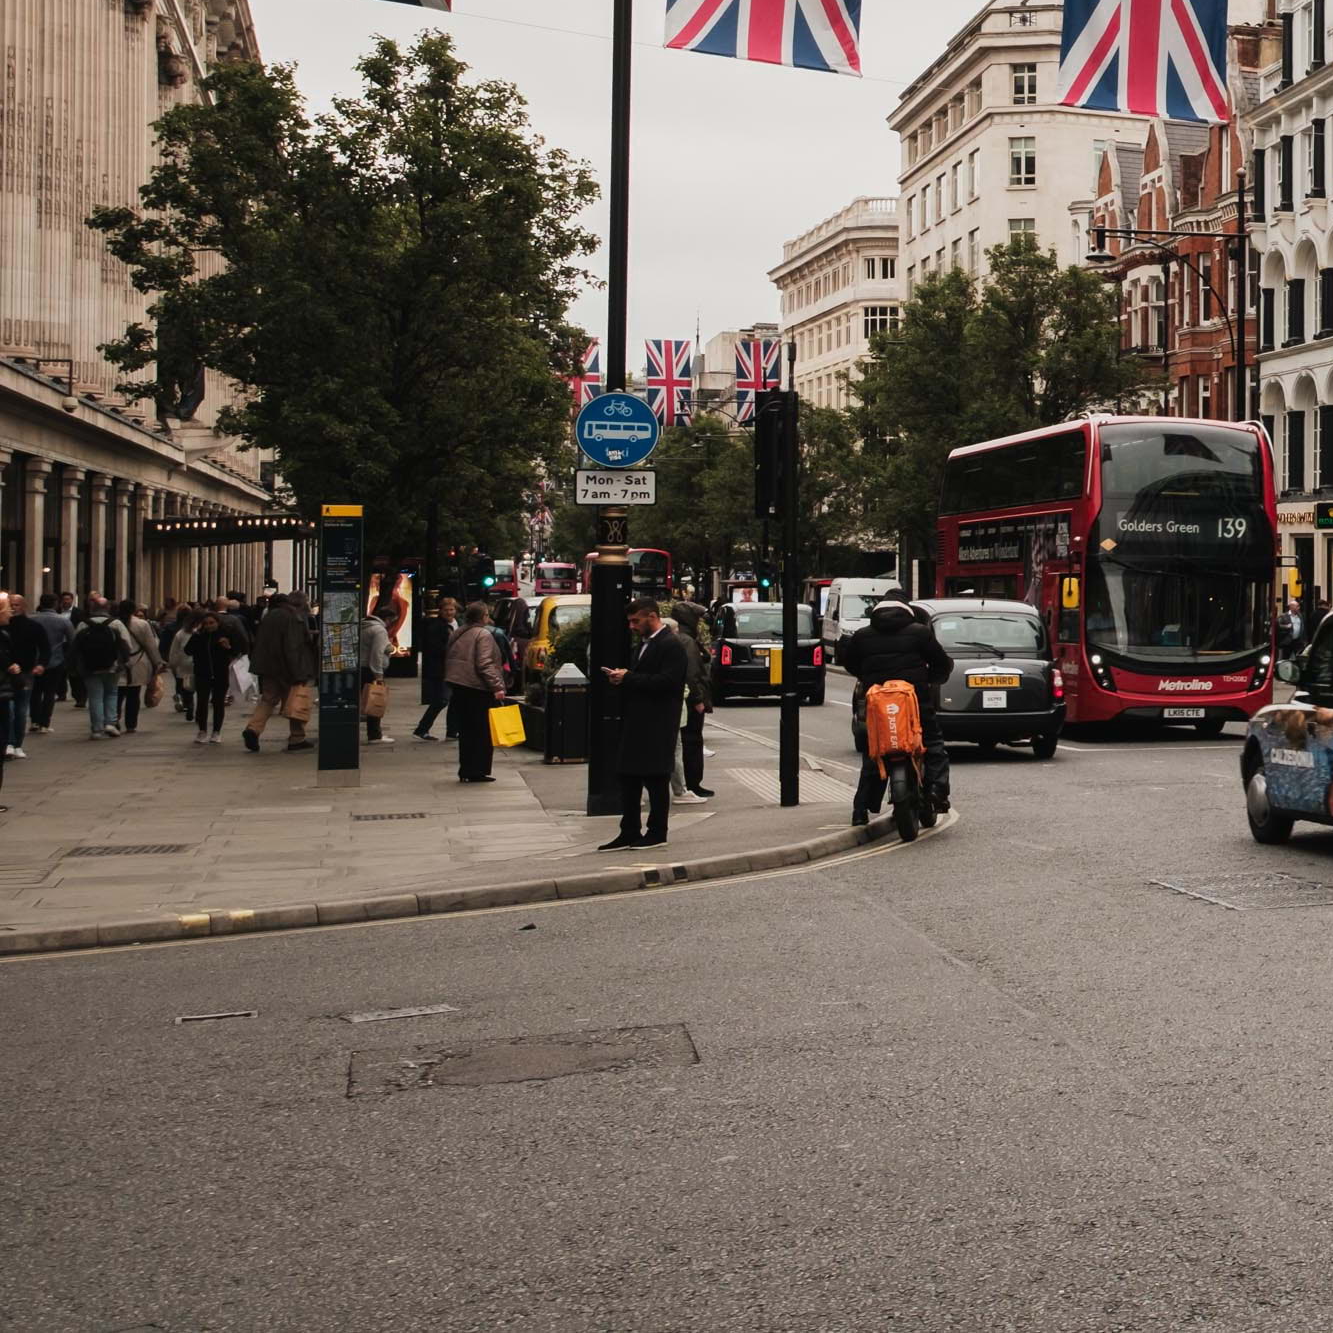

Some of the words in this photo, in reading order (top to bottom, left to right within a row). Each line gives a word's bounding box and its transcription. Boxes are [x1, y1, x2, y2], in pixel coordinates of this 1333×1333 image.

[586, 475, 613, 485] Mon
[624, 475, 647, 485] Sat
[1119, 519, 1163, 532] Golders
[1166, 521, 1199, 533] Green
[1217, 518, 1246, 538] 139
[1158, 678, 1213, 691] Metroline
[888, 715, 897, 734] JUST
[890, 735, 898, 749] EAT
